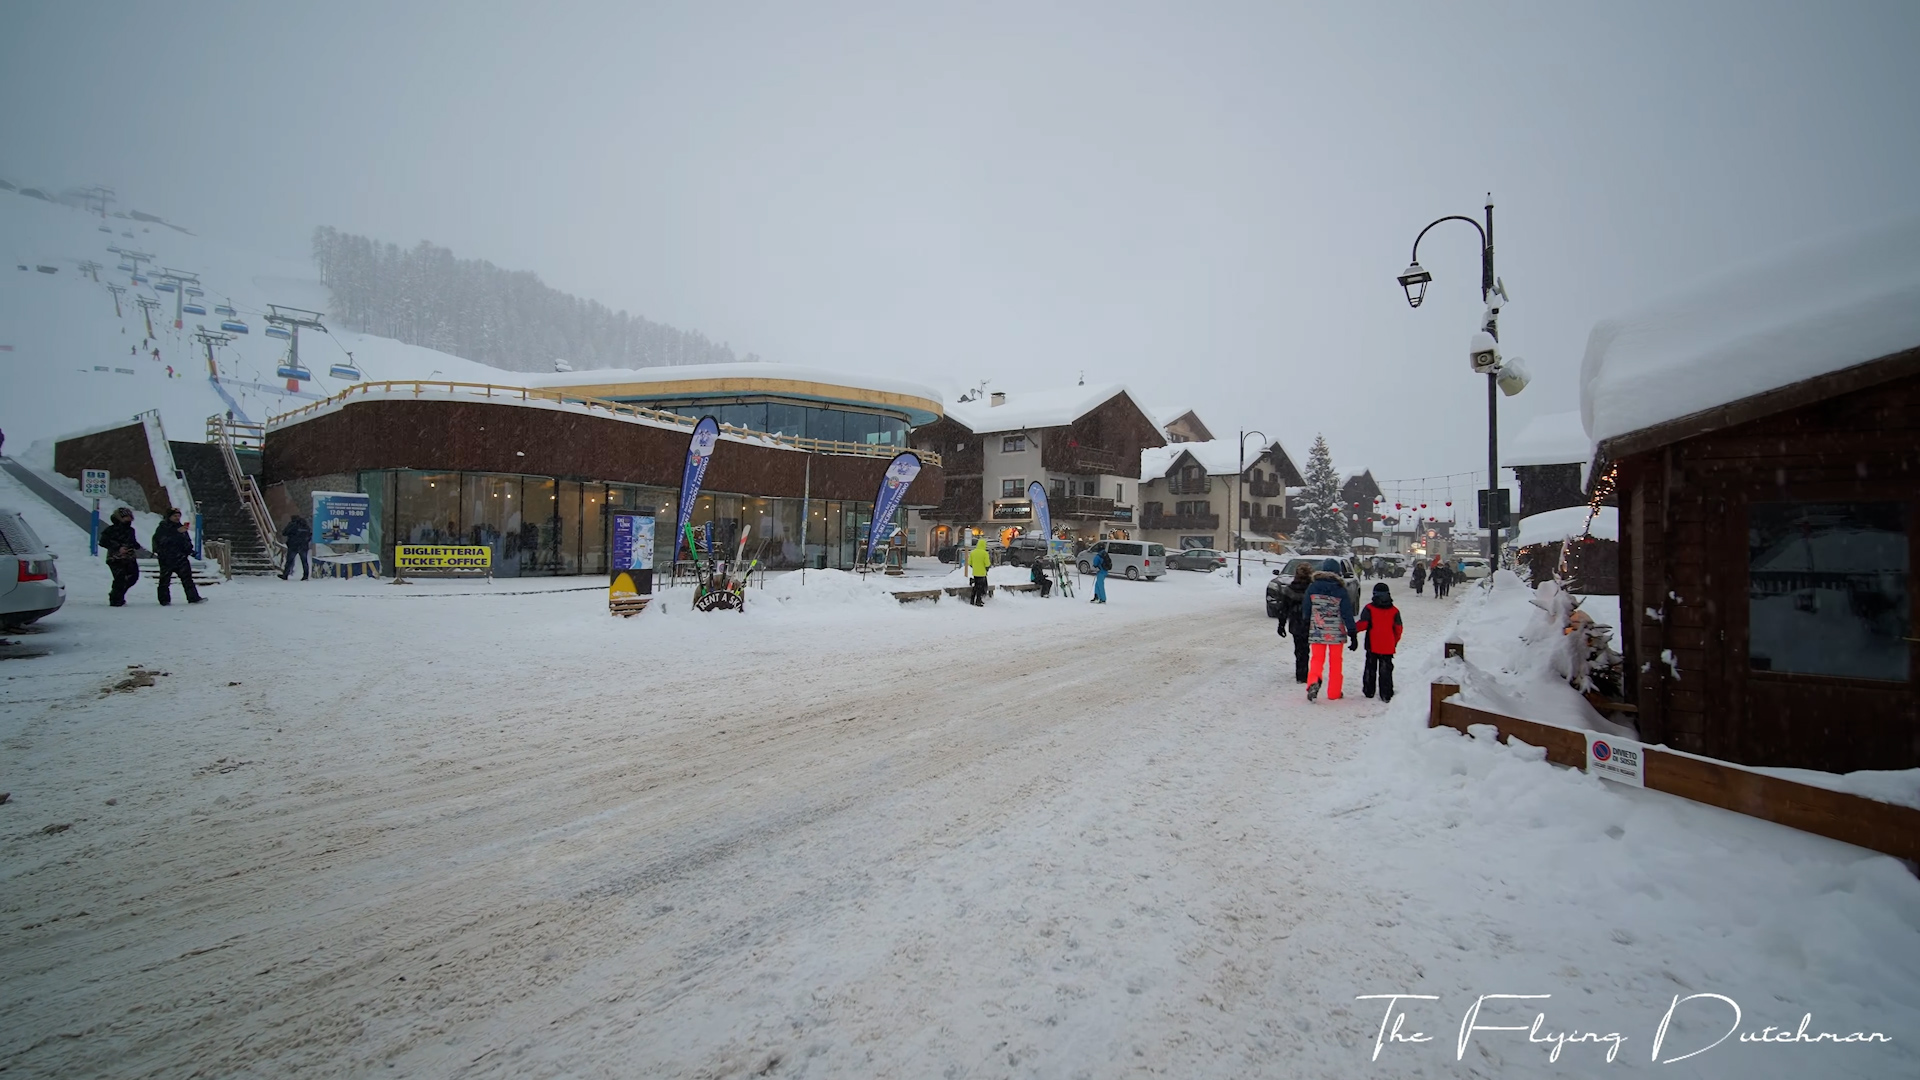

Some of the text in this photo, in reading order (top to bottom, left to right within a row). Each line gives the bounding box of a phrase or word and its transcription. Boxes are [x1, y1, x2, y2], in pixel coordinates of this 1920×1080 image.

[688, 486, 699, 514] SCHOOL
[697, 456, 709, 485] LIVIGNO
[872, 533, 880, 546] NEW
[878, 523, 886, 533] SKI
[883, 503, 897, 525] SCHOOL
[895, 482, 909, 503] LIVIGNO
[699, 593, 741, 610] RENT A SKI
[1612, 747, 1637, 760] DIVIETO
[1620, 758, 1637, 767] SOSTA
